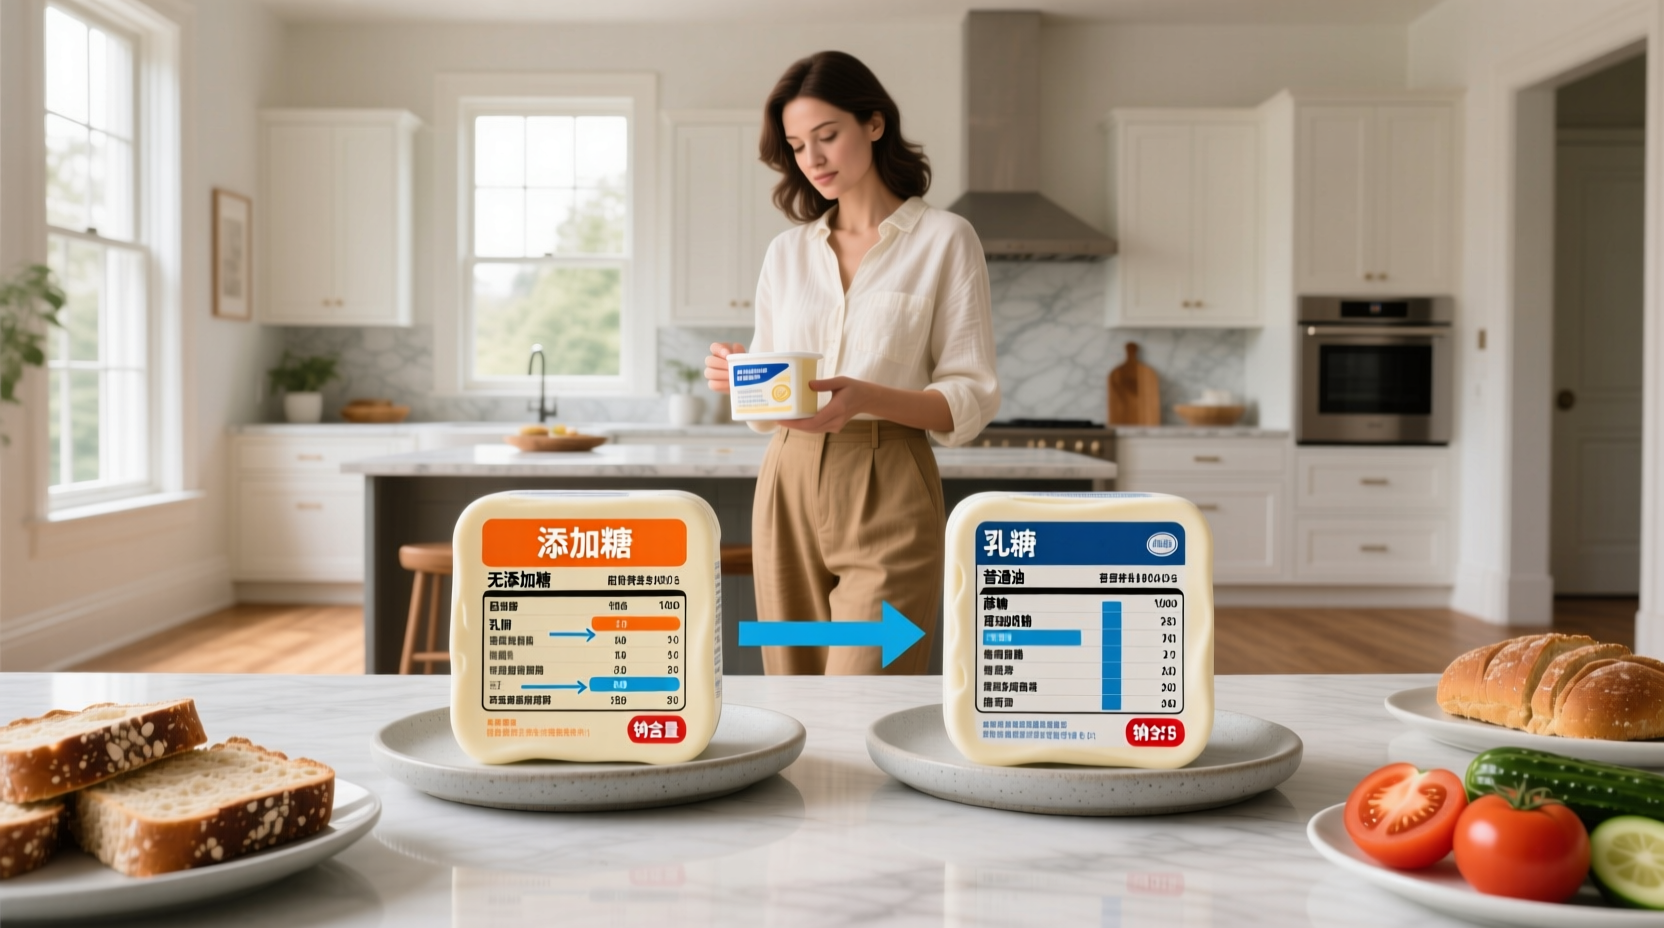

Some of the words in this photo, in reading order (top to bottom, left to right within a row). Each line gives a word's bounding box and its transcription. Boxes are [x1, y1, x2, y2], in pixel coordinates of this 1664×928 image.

[537, 526, 633, 560] 添加糖
[983, 528, 1037, 558] 乳糖
[487, 571, 552, 589] 无添加糖
